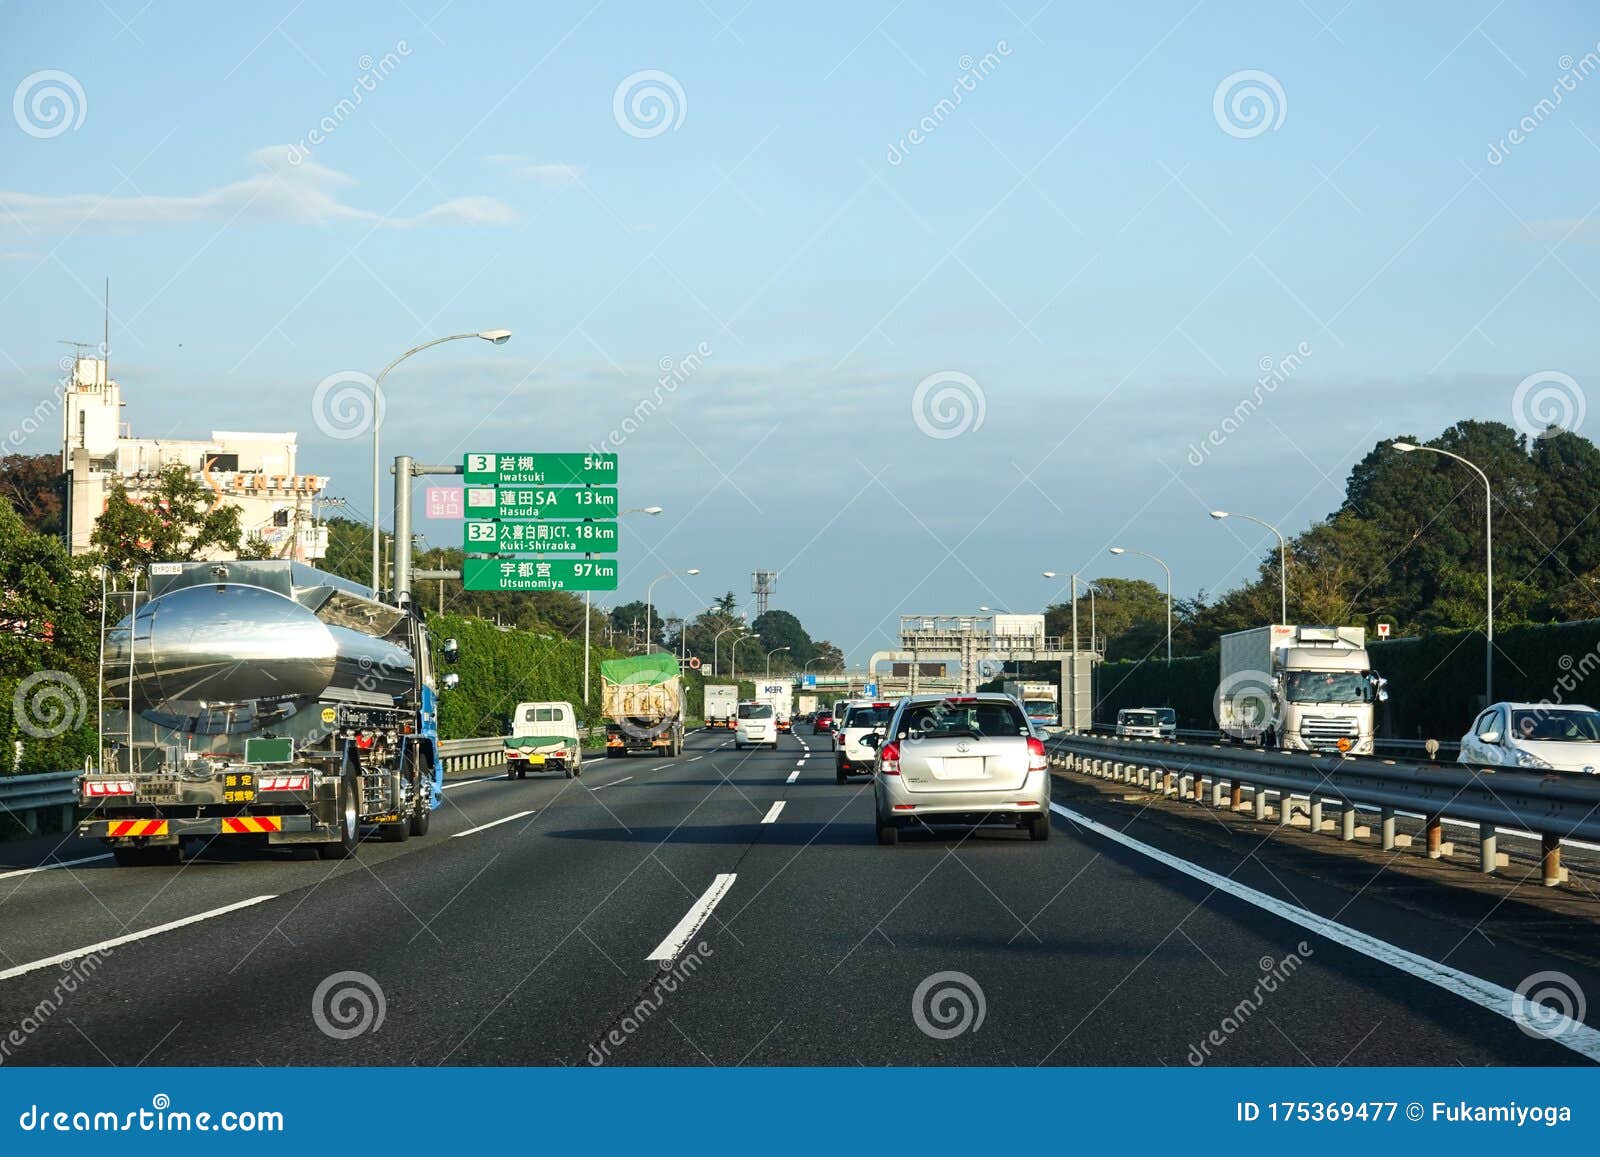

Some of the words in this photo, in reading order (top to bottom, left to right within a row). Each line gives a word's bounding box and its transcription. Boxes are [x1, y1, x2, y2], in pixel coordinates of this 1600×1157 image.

[476, 456, 487, 471] 3
[500, 456, 535, 472] 岩槻
[500, 472, 545, 482] Iwatsuki
[431, 490, 459, 502] ETC
[432, 504, 458, 515] 出口
[500, 506, 539, 516] Hasuda
[470, 525, 495, 540] 3-2
[500, 540, 577, 551] Kuki-Shiraoka
[500, 562, 552, 578] 宇都宮
[500, 578, 564, 590] Utsunomiya
